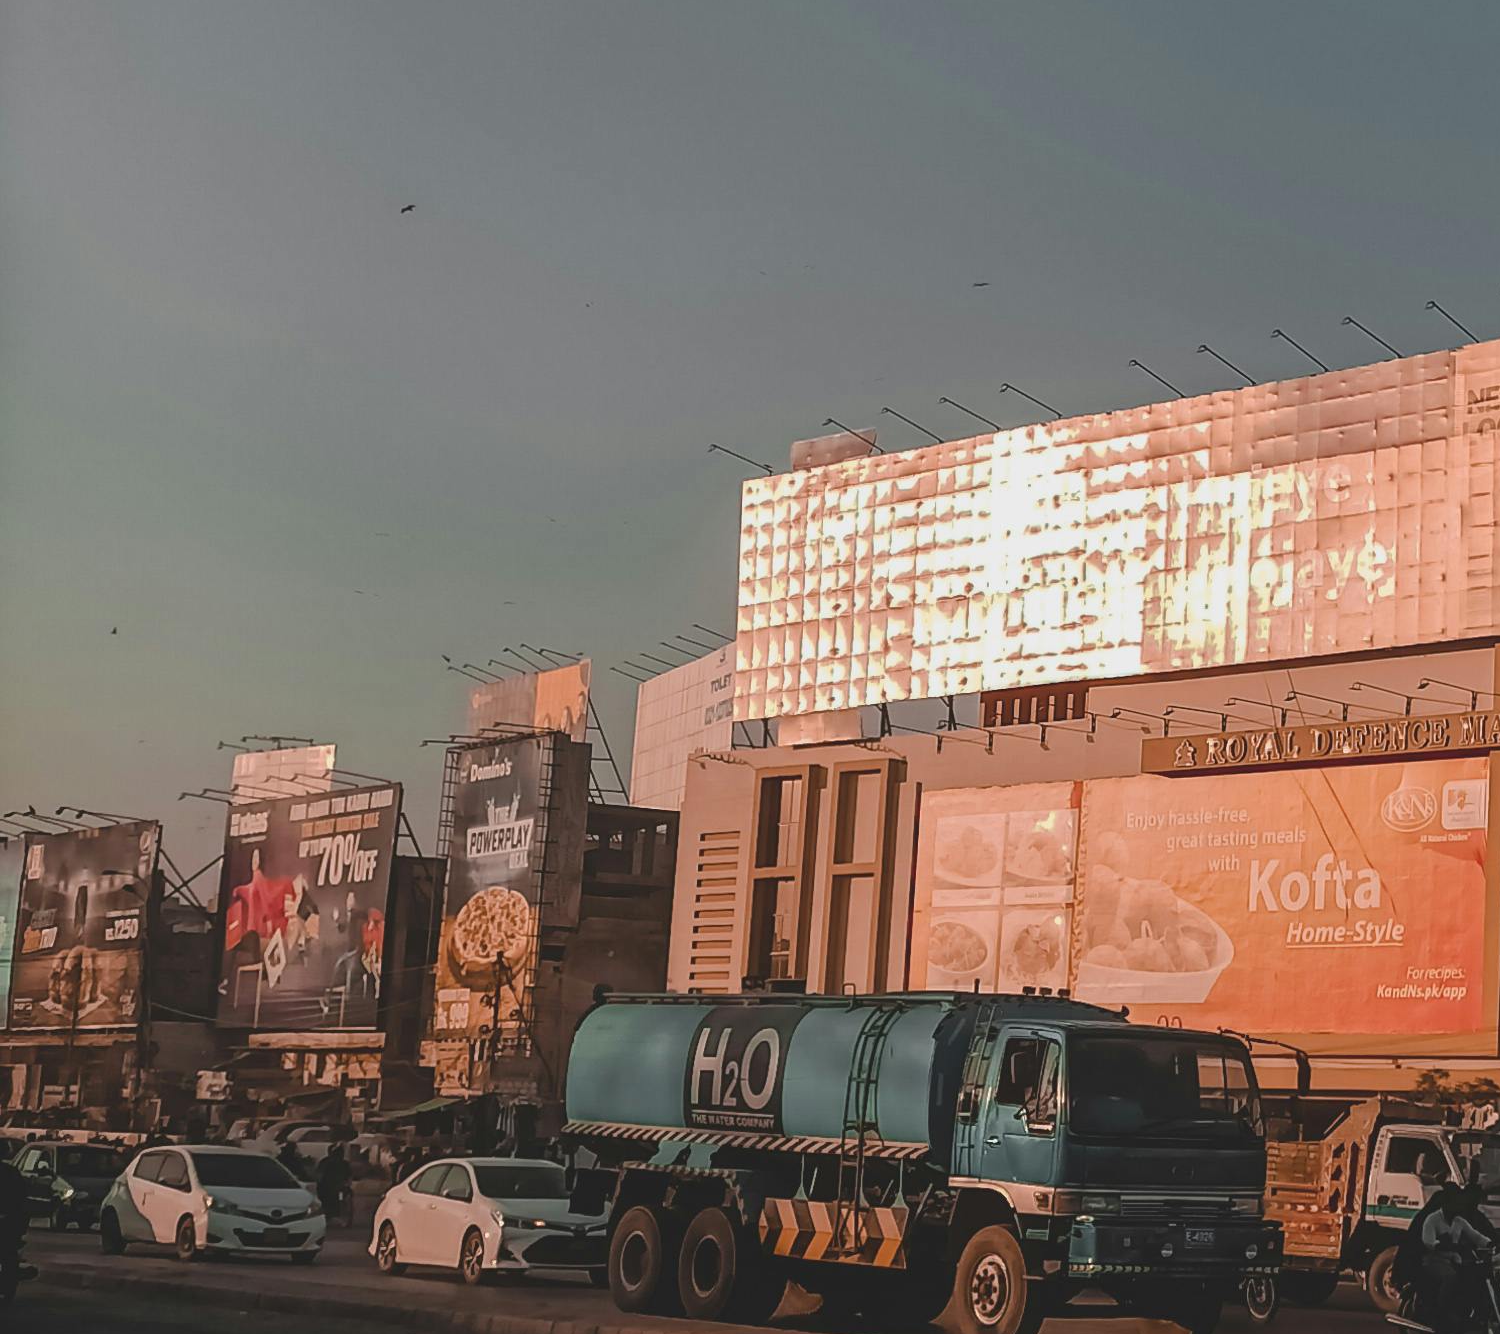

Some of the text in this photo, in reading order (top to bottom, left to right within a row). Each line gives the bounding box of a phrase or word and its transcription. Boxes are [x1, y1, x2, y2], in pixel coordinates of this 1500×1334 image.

[1205, 727, 1300, 765] ROYAL
[1310, 718, 1450, 756] DEFENCE
[1126, 812, 1166, 831] Enjoy
[469, 824, 531, 855] POWERPLAY
[1166, 825, 1307, 852] great tasting meals
[317, 832, 361, 886] 70%
[354, 849, 379, 883] OFF
[1208, 852, 1382, 913] with Kofta
[1286, 919, 1405, 947] Home-Style
[1376, 982, 1468, 1001] KandNs.pk/app
[690, 1027, 780, 1110] H2O
[691, 1113, 706, 1125] THE
[707, 1114, 735, 1127] WATER
